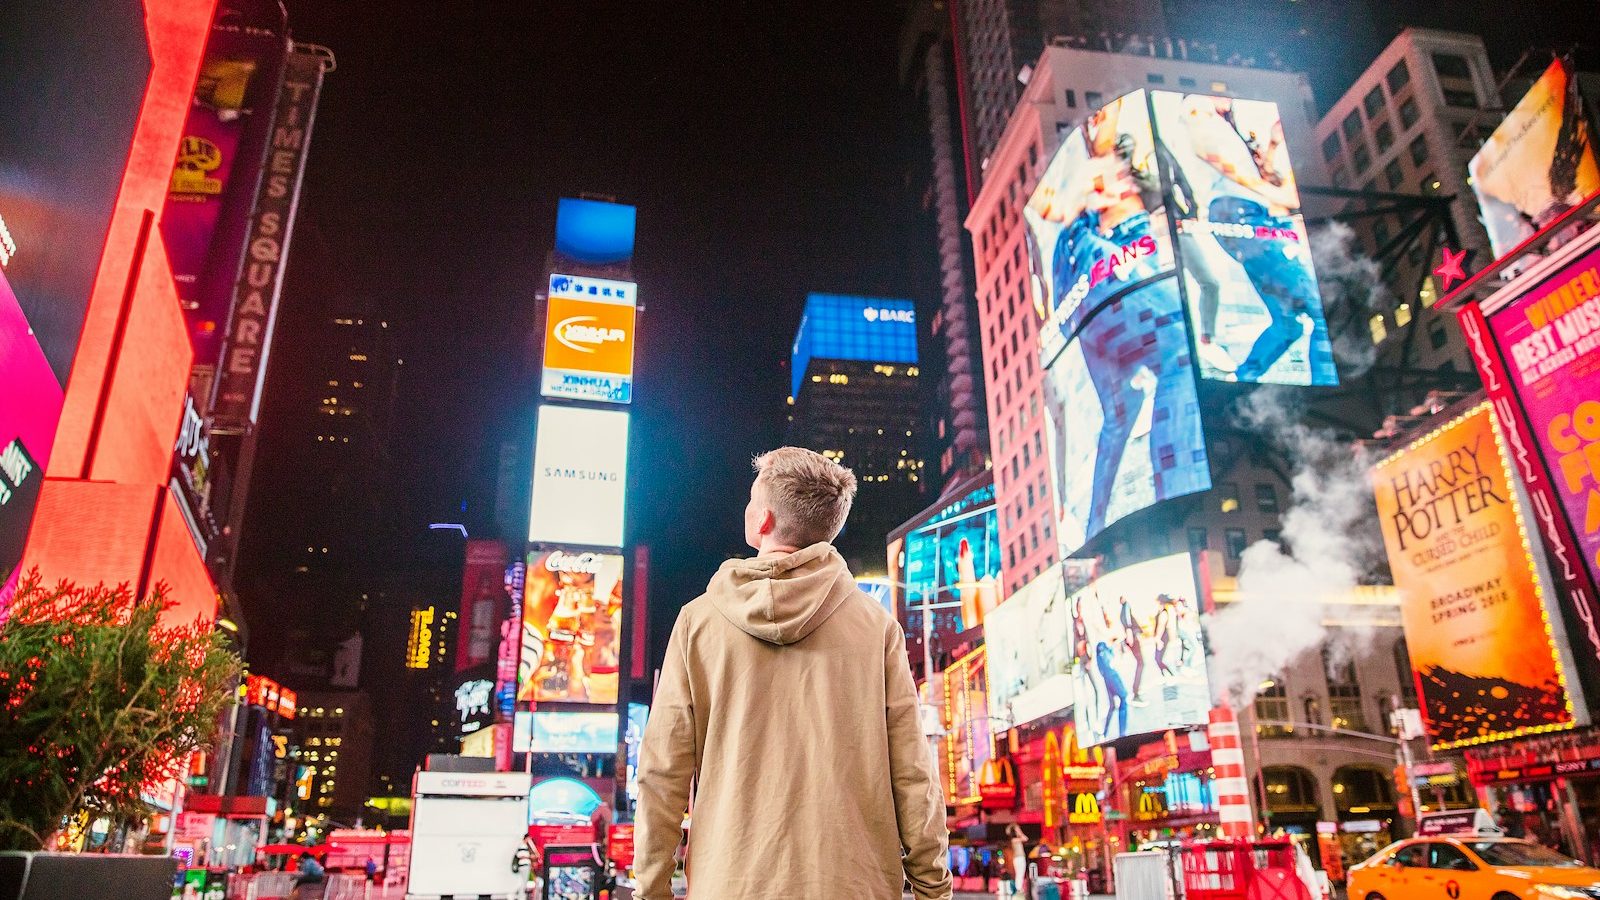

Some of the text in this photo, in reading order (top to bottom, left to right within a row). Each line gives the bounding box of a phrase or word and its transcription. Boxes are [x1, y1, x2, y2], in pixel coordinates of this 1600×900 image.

[231, 81, 310, 376] TIMES SQUARE
[1090, 235, 1156, 288] JEANS
[1511, 325, 1558, 372] BEST
[544, 467, 617, 482] SAMSUNG
[1392, 434, 1483, 508] HARRY
[1393, 483, 1505, 551] POTTER
[1431, 578, 1501, 610] BROADWAY
[1431, 602, 1477, 624] SPRING
